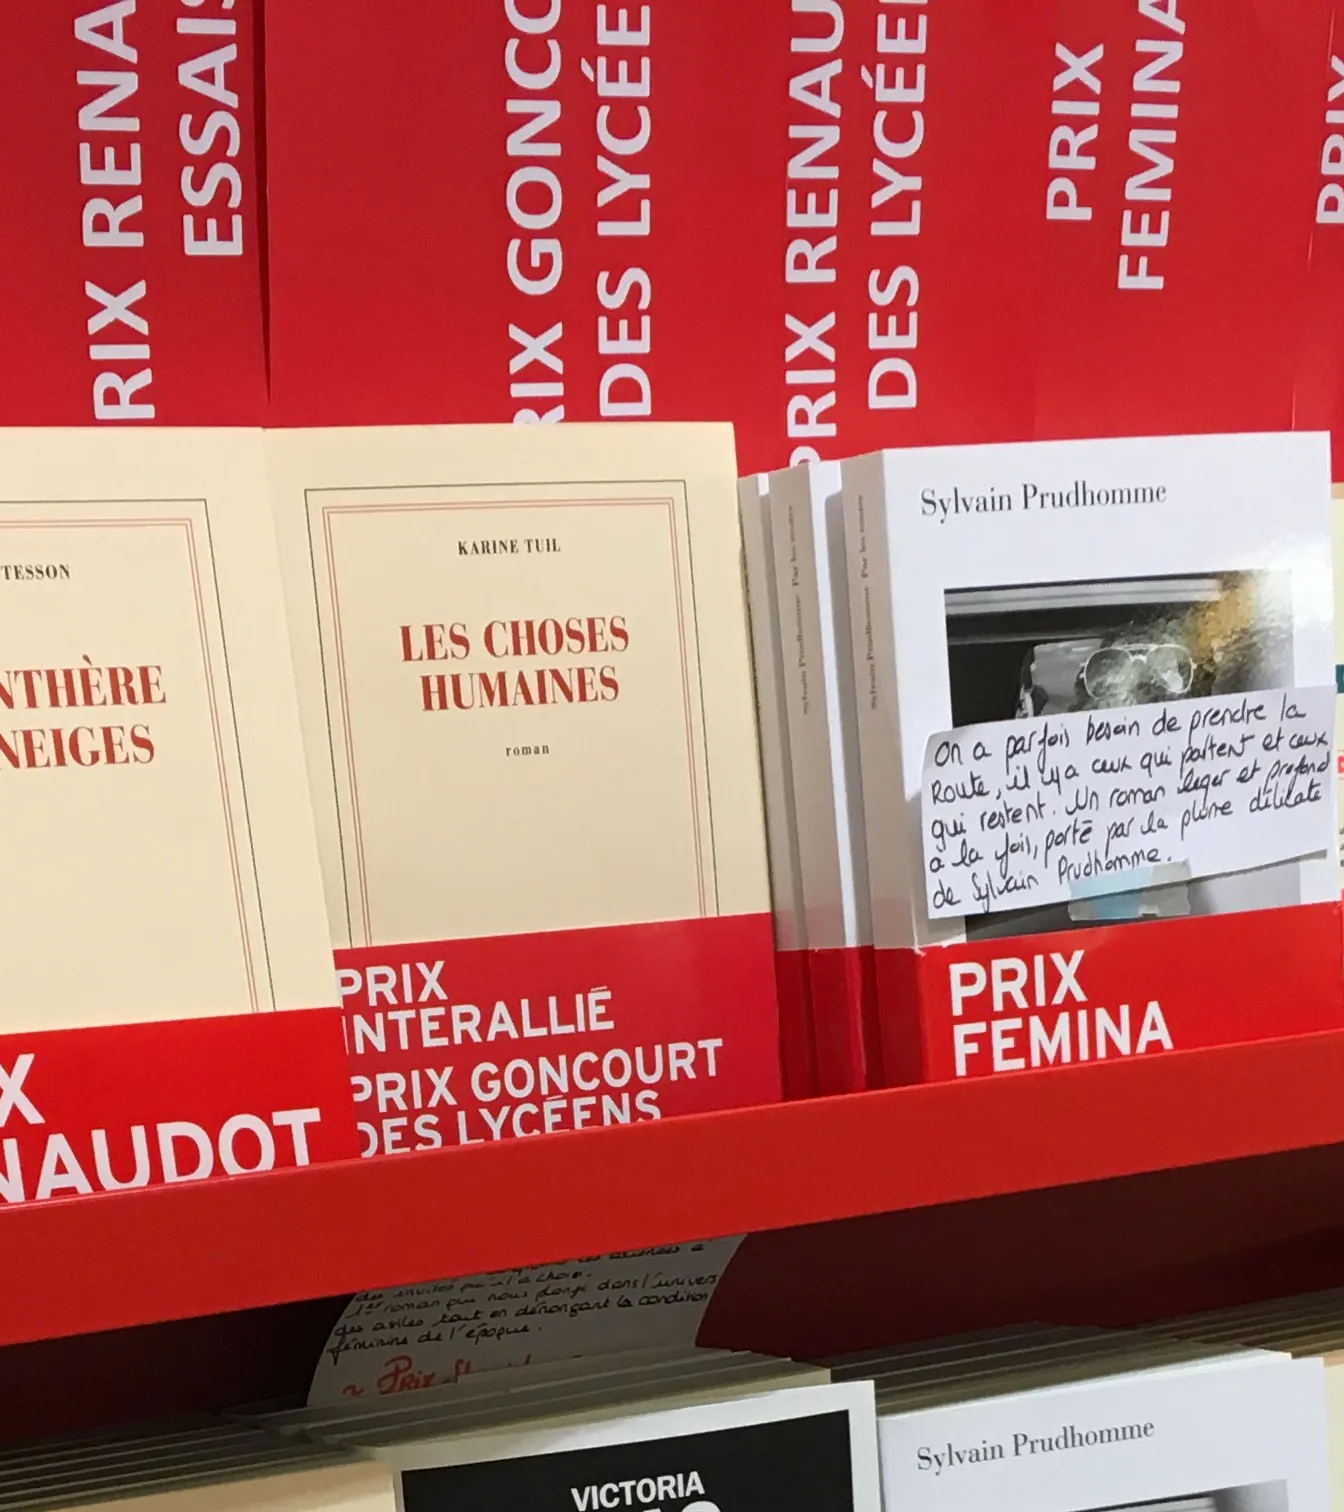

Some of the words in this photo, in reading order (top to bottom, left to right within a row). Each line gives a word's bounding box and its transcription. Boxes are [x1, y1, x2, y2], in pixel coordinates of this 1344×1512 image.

[581, 4, 651, 236] LYCÉE
[1046, 43, 1104, 220] PRIX
[1118, 0, 1186, 290] FEMINA
[597, 268, 651, 416] DES
[868, 265, 918, 409] DES
[921, 487, 1013, 524] Sylvain
[1022, 480, 1167, 512] Prudhomme
[1, 562, 72, 582] TESSON
[456, 538, 518, 557] KARINE
[524, 537, 561, 555] TUIL
[399, 622, 472, 664] LES
[483, 615, 630, 659] CHOSES
[419, 665, 621, 712] HUMAINES
[504, 742, 551, 758] roman
[972, 741, 991, 761] a
[1152, 709, 1183, 733] de
[1188, 698, 1267, 737] prendre
[1280, 693, 1307, 720] la
[335, 960, 448, 1007] PRIX
[949, 949, 1088, 1017] PRIX
[953, 1000, 1174, 1077] FEMINA
[470, 1038, 723, 1102] GONCOURT
[916, 1441, 1004, 1475] Sylvain
[1012, 1420, 1156, 1458] Prudhomme
[571, 1470, 706, 1512] VICTORIA
